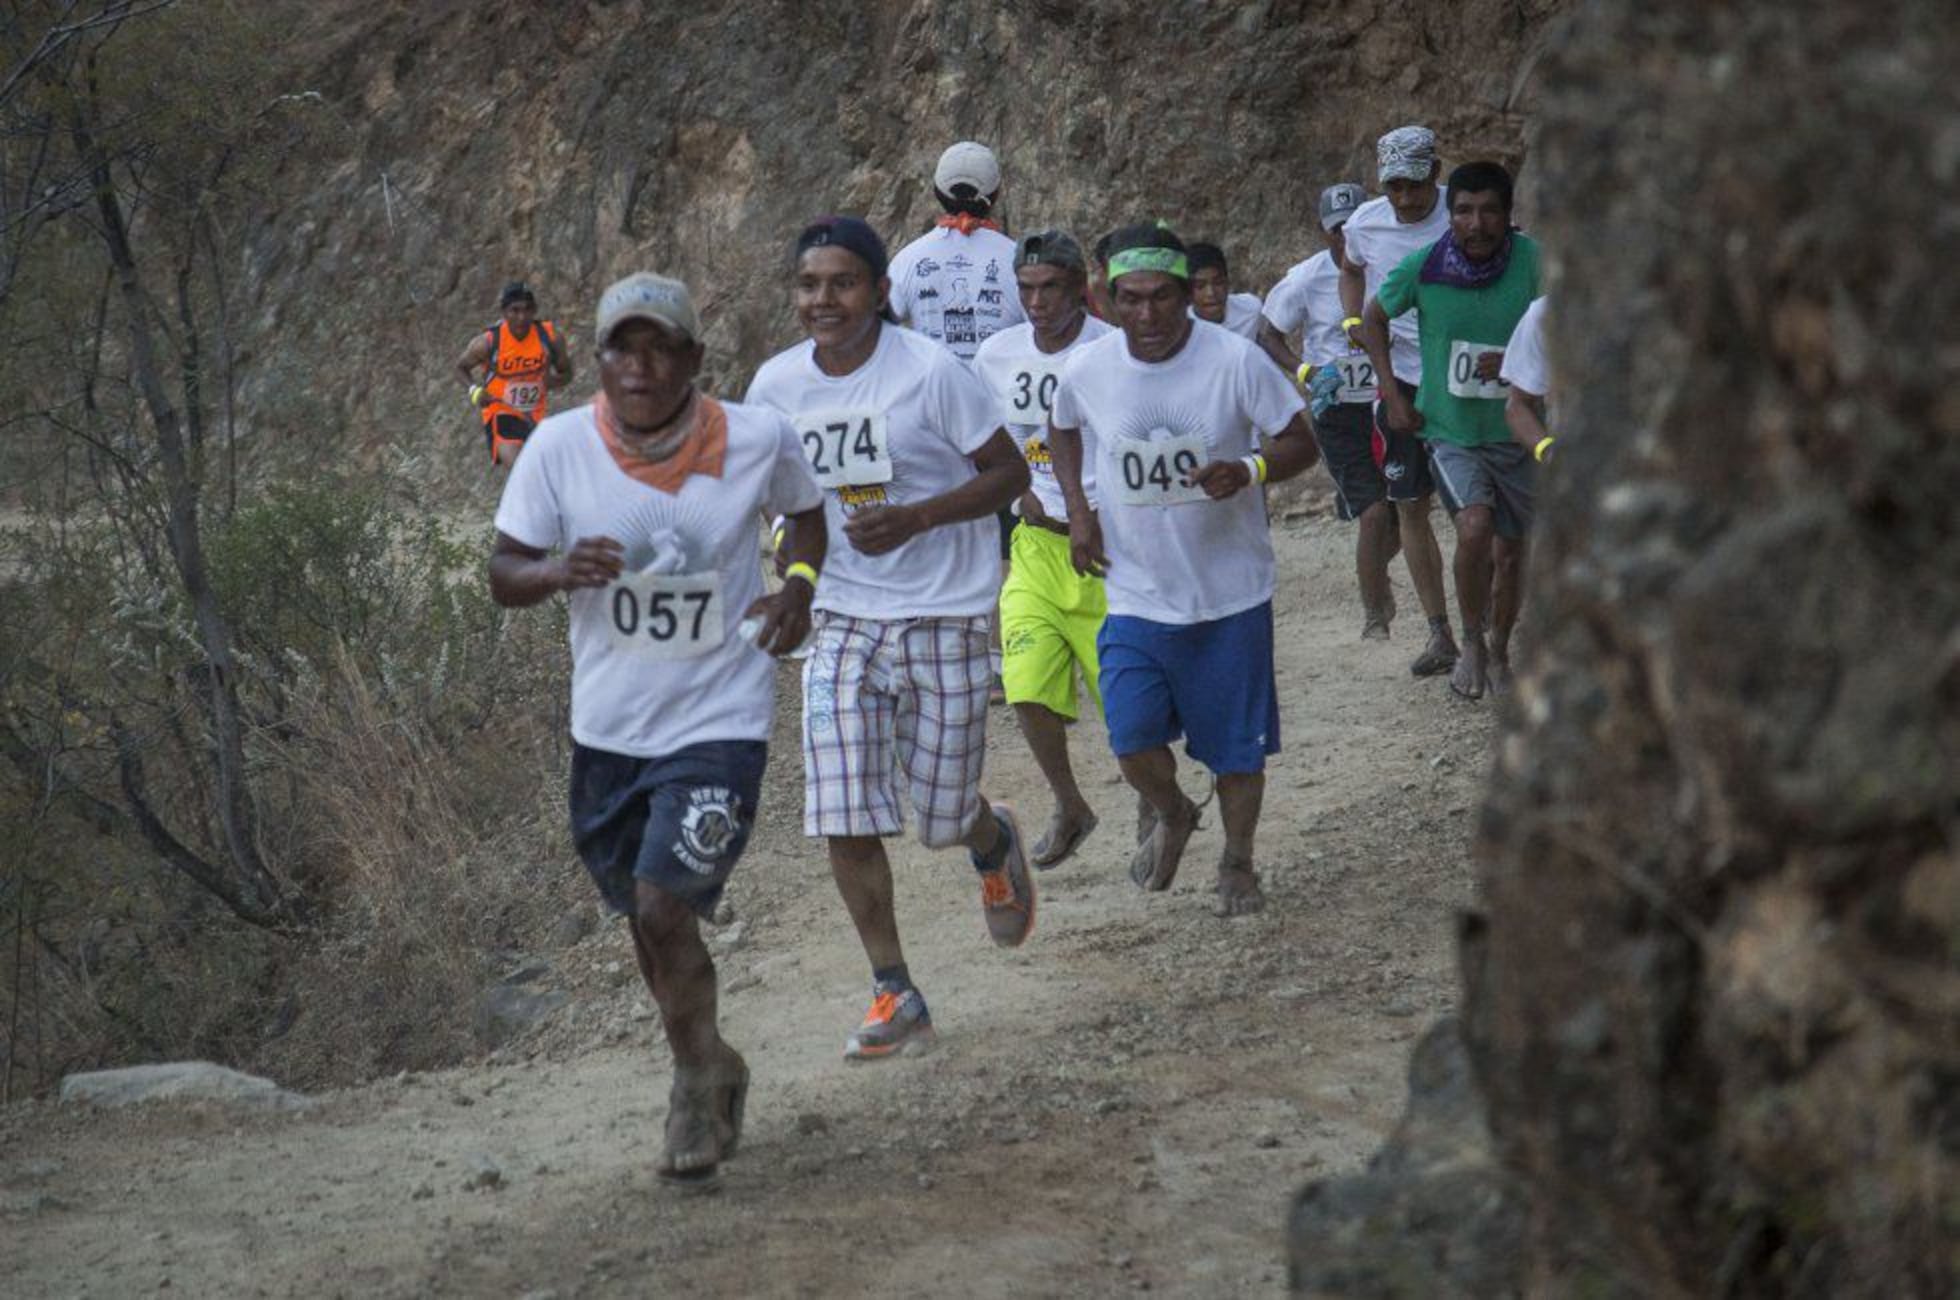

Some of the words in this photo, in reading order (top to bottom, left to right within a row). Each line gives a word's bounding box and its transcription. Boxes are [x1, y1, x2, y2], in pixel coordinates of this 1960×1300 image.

[510, 386, 539, 404] 192
[803, 417, 878, 474] 274
[1123, 449, 1199, 492] 049
[612, 586, 712, 641] 057
[690, 786, 730, 806] NEW
